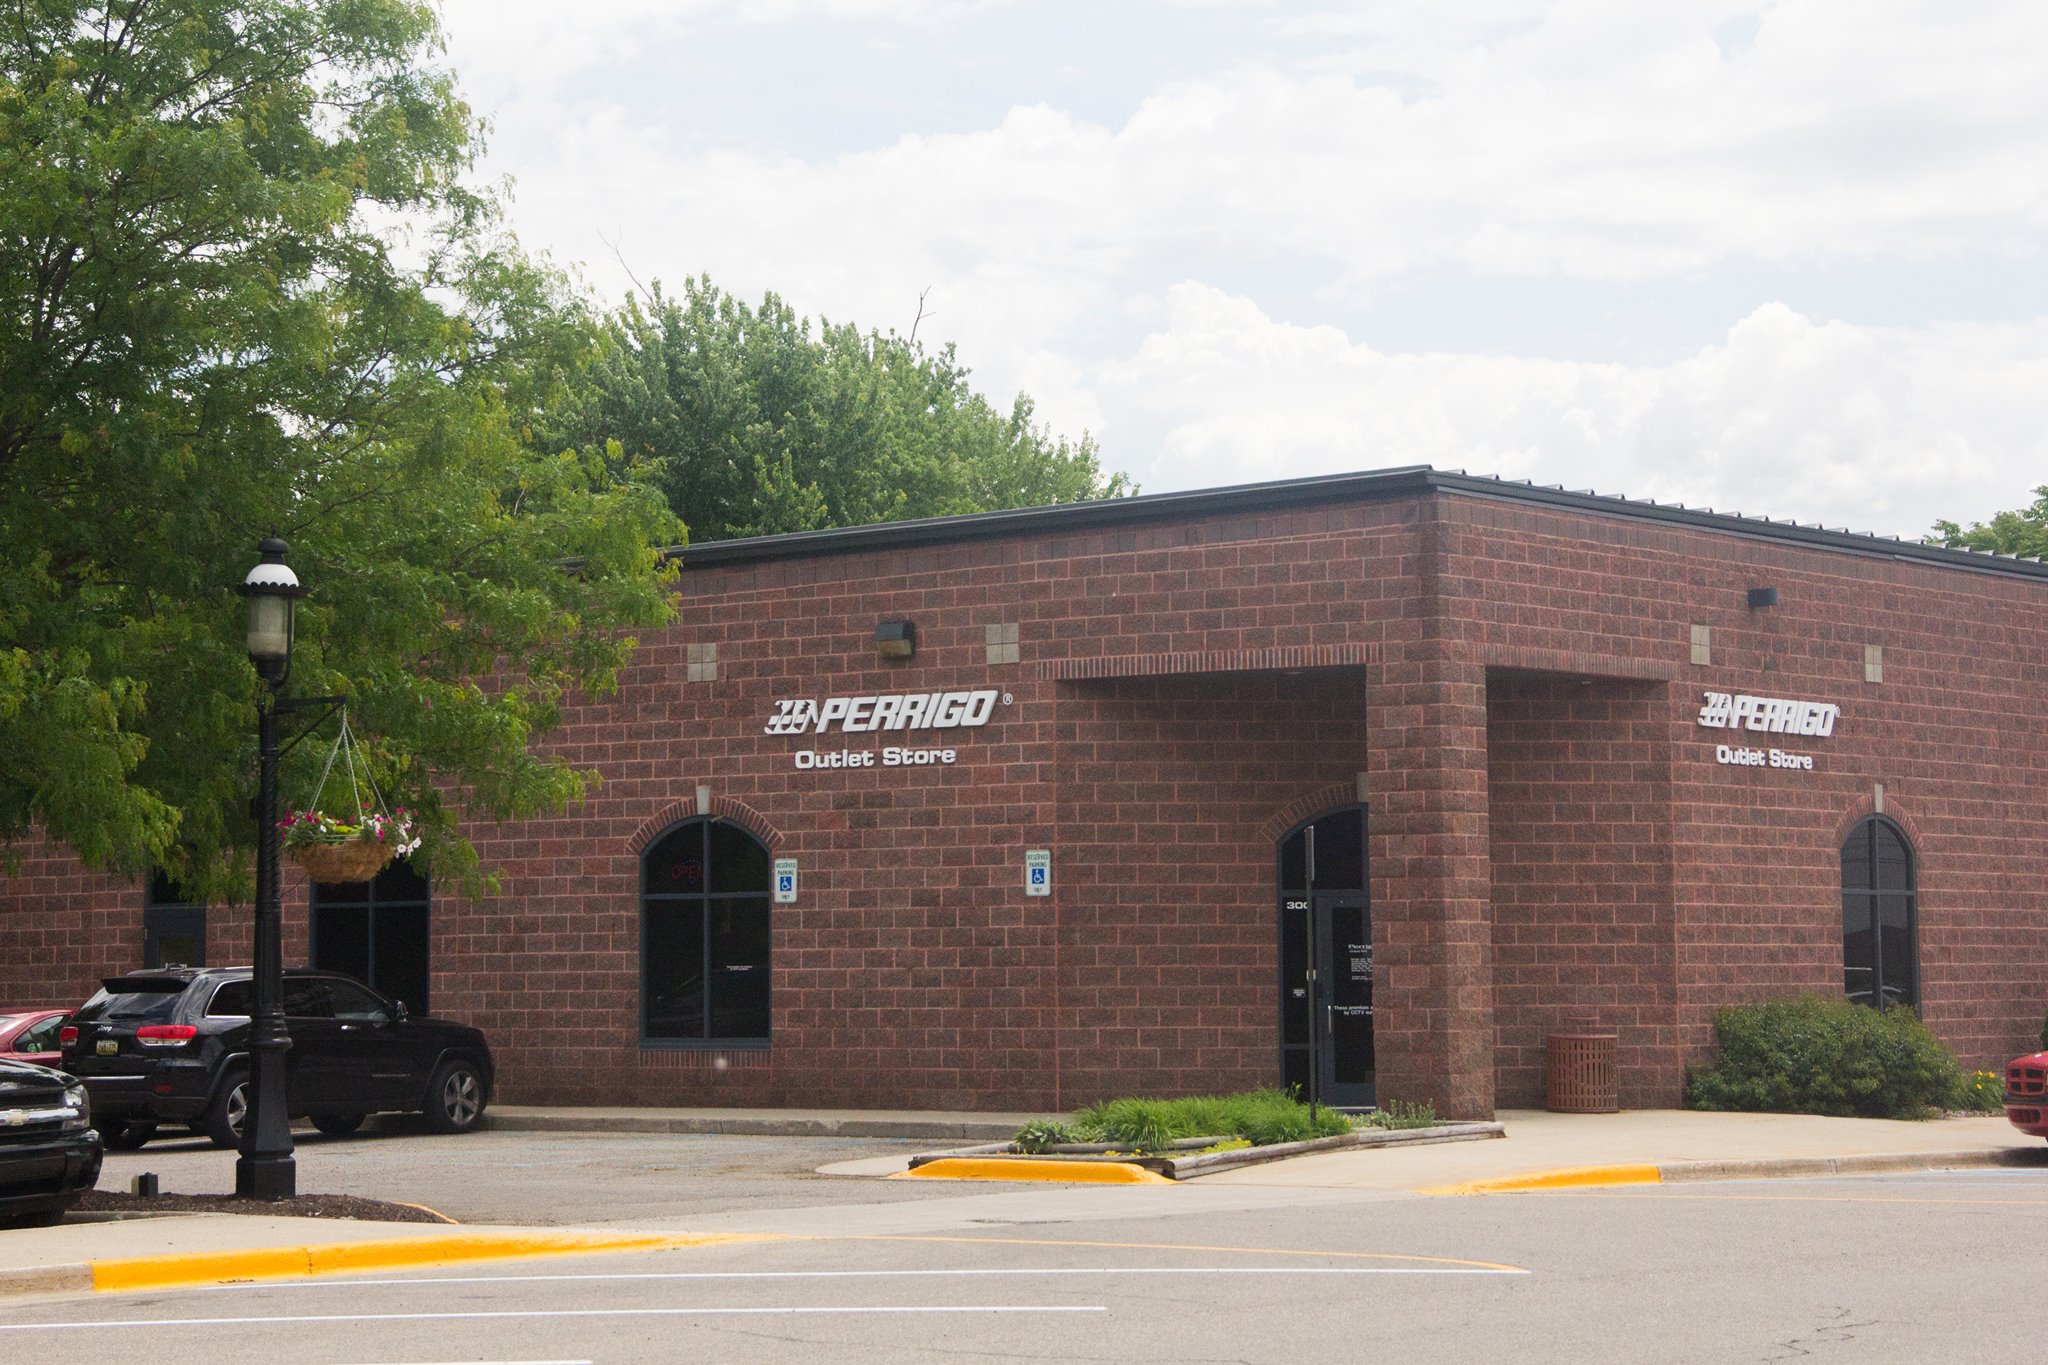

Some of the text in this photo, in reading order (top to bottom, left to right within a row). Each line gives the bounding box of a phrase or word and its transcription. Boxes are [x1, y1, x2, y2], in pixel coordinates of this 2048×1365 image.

[814, 690, 999, 733] PERRIGO
[1729, 695, 1836, 737] PERRIGO
[795, 747, 956, 769] Outlet Store
[1716, 745, 1813, 770] Outlet Store
